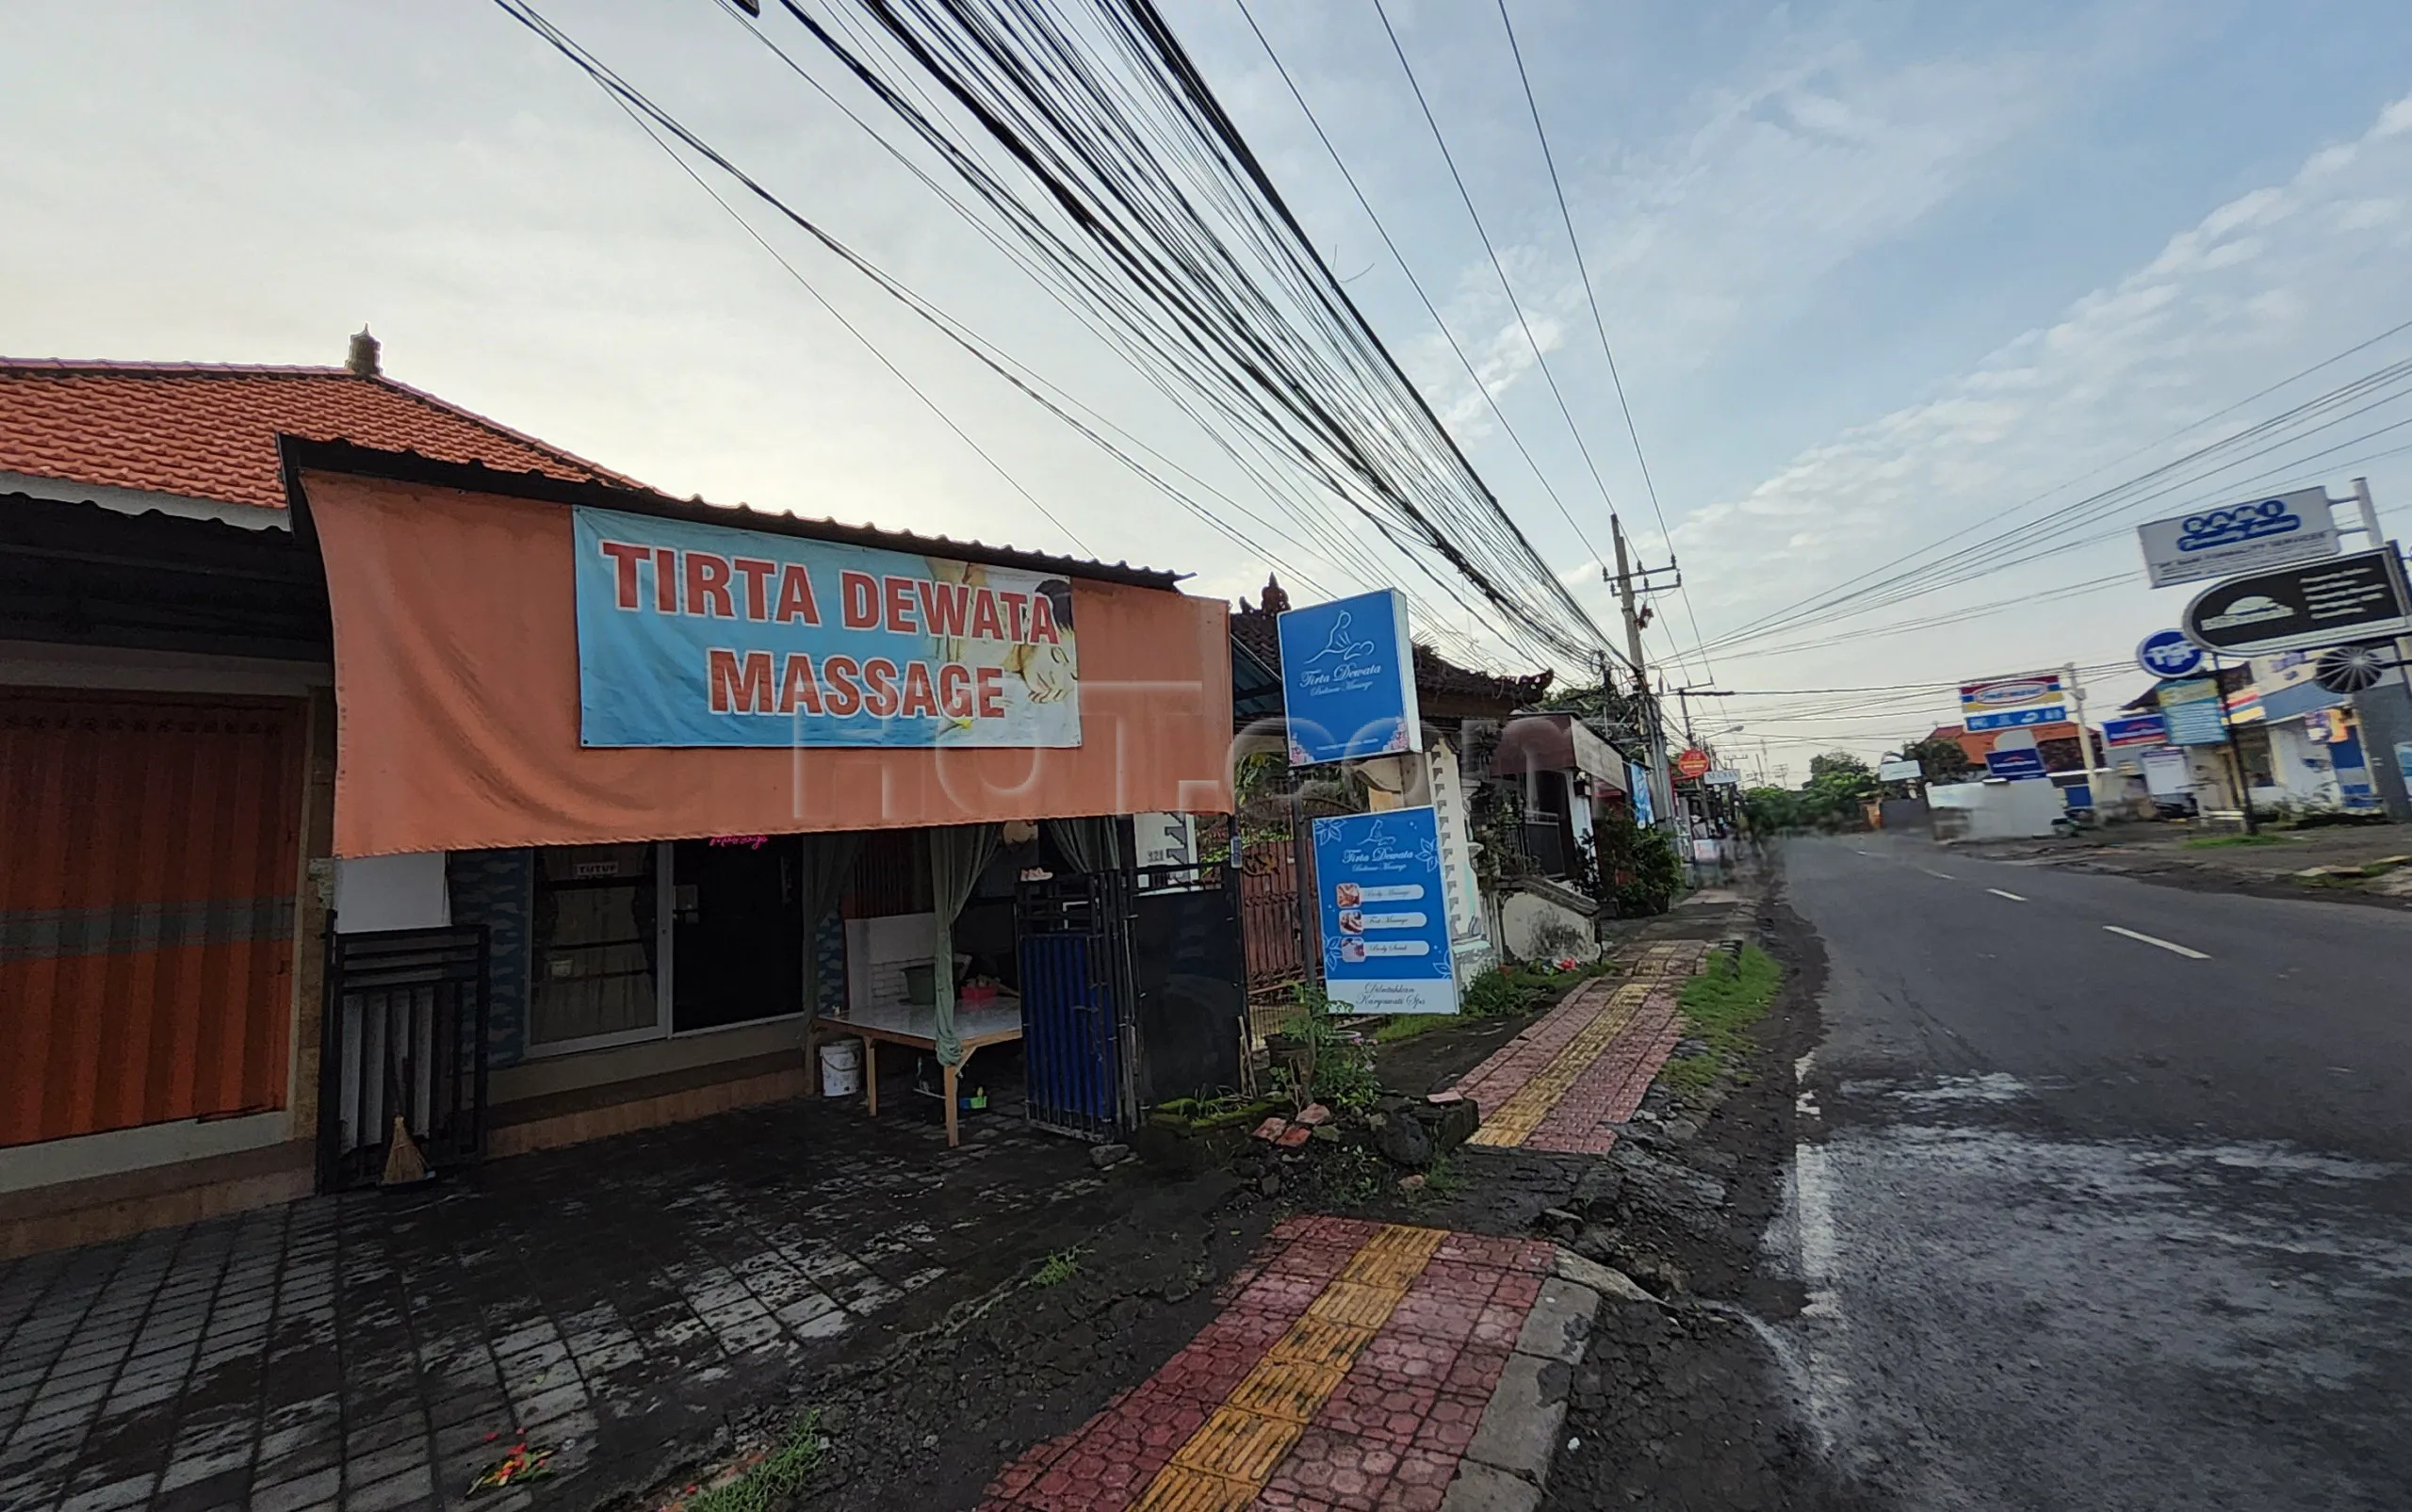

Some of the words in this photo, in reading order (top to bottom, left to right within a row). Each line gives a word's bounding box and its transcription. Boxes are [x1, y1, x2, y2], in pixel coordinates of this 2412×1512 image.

[599, 539, 823, 628] TIRTA
[839, 568, 1062, 646] DEWATA
[707, 646, 1007, 720] MASSAGE
[1300, 669, 1330, 688] Tirta
[1332, 662, 1382, 682] Dewata
[1342, 848, 1370, 864] Tirta
[1371, 846, 1414, 862] Dewata
